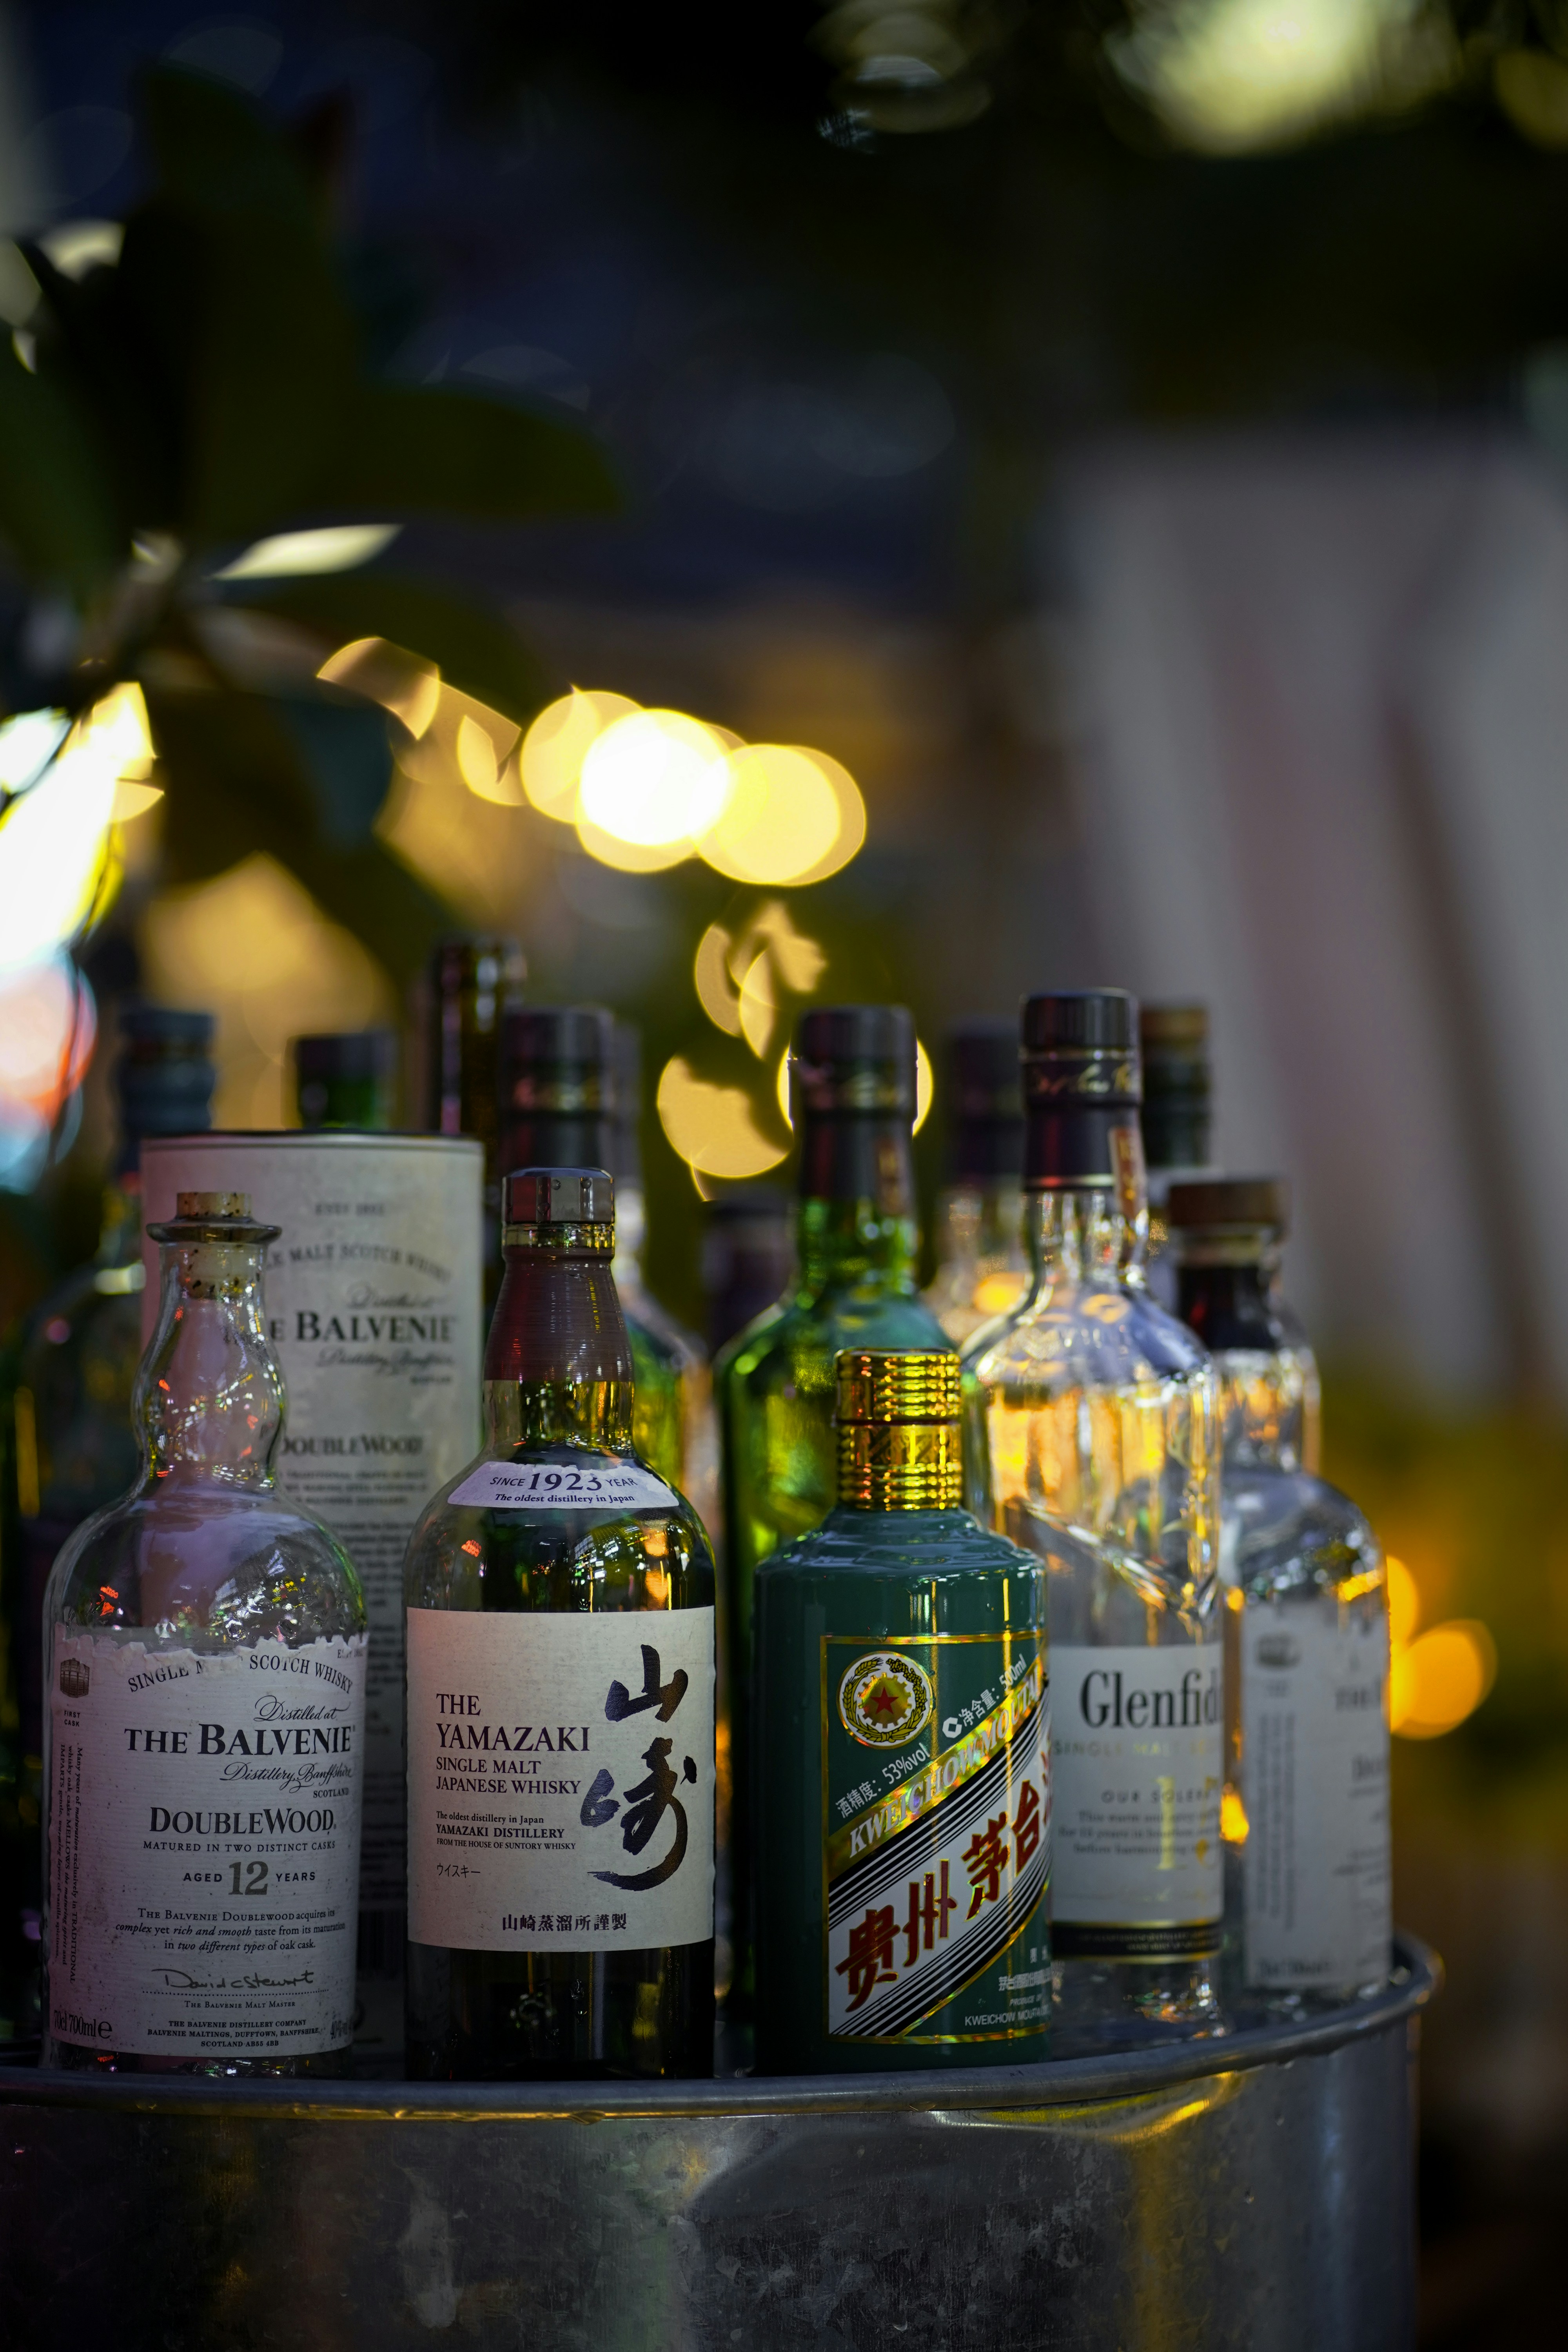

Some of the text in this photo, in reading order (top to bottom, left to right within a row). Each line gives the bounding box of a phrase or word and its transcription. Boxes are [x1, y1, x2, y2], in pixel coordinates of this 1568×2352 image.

[297, 1310, 451, 1342] BALVENIE
[490, 1472, 638, 1491] SINCE 1923 YEAR
[495, 1494, 635, 1504] The oldest distillery in Japan
[250, 1655, 310, 1674] SCOTCH
[315, 1662, 352, 1694] WHISKY
[999, 1653, 1027, 1691] 500ml
[254, 1695, 351, 1722] Distilled at
[436, 1693, 481, 1716] THE
[124, 1724, 352, 1755] THE BALVENIE
[436, 1723, 590, 1751] YAMAZAKI
[436, 1757, 541, 1774] SINGLE MALT
[579, 1644, 697, 1891] 山崎
[882, 1742, 930, 1784] 53%vol
[289, 1762, 352, 1793] Banffshire
[436, 1776, 581, 1794] JAPANESE WHISKY
[75, 1796, 81, 1805] of
[313, 1788, 349, 1798] SCOTLAND
[849, 1735, 978, 1858] KWEICHOW
[436, 1811, 447, 1819] The
[449, 1812, 469, 1821] oldest
[472, 1814, 506, 1825] distillery
[519, 1816, 544, 1825] Japan
[436, 1824, 564, 1838] YAMAZAKI DISTILLERY
[143, 1841, 201, 1852] MATURED
[257, 1843, 308, 1852] DISTINCT
[312, 1841, 336, 1850] CASKS
[183, 1861, 316, 1895] AGED 12 YEARS
[437, 1863, 481, 1878] ウイスキー
[835, 1729, 1052, 2013] 贵州茅台
[57, 1883, 62, 1893] of
[296, 1911, 326, 1922] acquires
[115, 1922, 345, 1936] complex yet rich and smooth taste from its maturation
[164, 1940, 316, 1953] in two different types of oak cask.
[54, 2010, 67, 2031] 70cl
[69, 2014, 96, 2037] 700ml
[275, 2019, 307, 2027] COMPANY
[965, 2011, 1016, 2026] KWEICHOW
[189, 2030, 232, 2038] MALTINGS,
[235, 2030, 278, 2038] DUFFTOWN,
